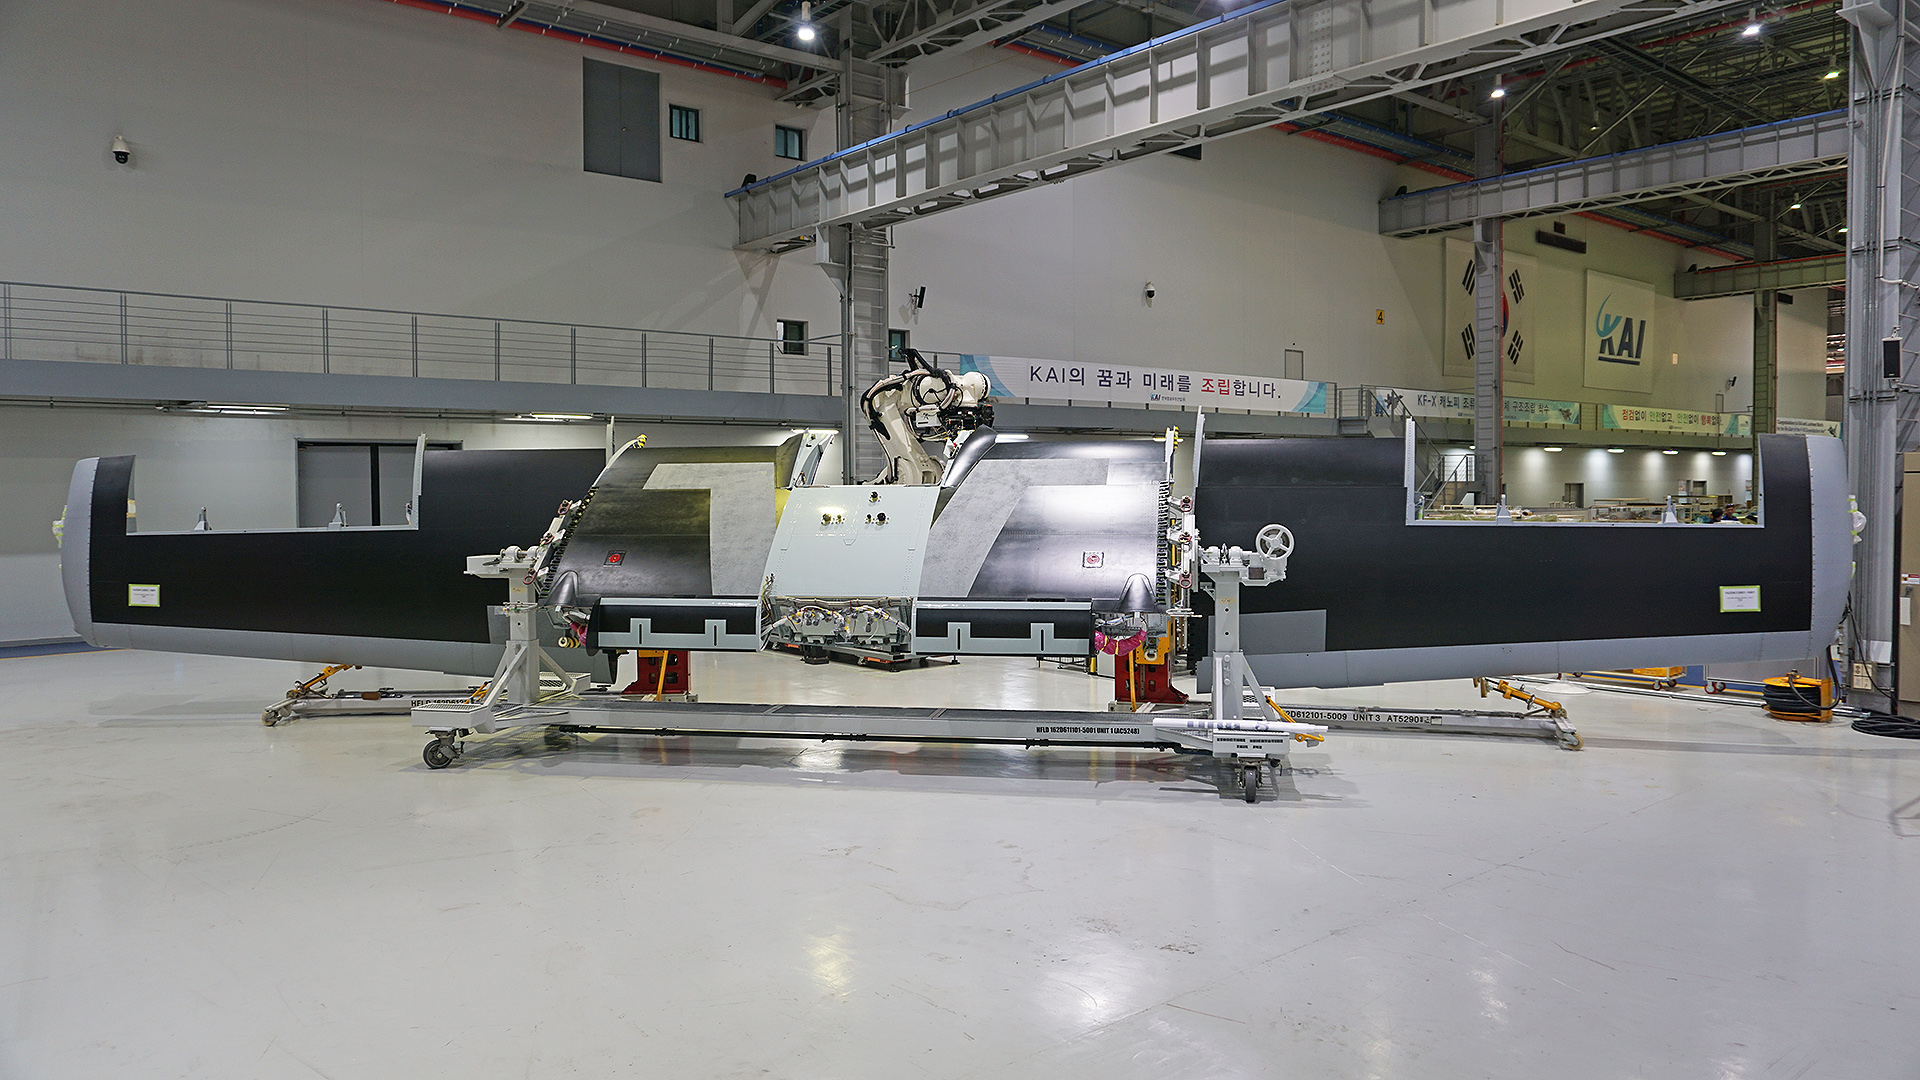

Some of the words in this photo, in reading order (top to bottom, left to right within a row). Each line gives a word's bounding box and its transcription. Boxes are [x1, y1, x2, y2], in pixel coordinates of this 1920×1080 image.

[1377, 311, 1384, 323] 4
[1596, 293, 1646, 359] KAI
[1030, 366, 1086, 386] KAI의
[1096, 369, 1132, 389] 꿈과
[1143, 372, 1192, 393] 미래를
[1201, 377, 1282, 399] 조립합니다.
[1417, 394, 1437, 407] KF-X
[1439, 395, 1460, 409] 캐노피
[1622, 409, 1647, 421] 점검없이
[1677, 412, 1699, 424] 안전없이
[1353, 713, 1374, 722] UNIT
[1375, 714, 1381, 722] 3
